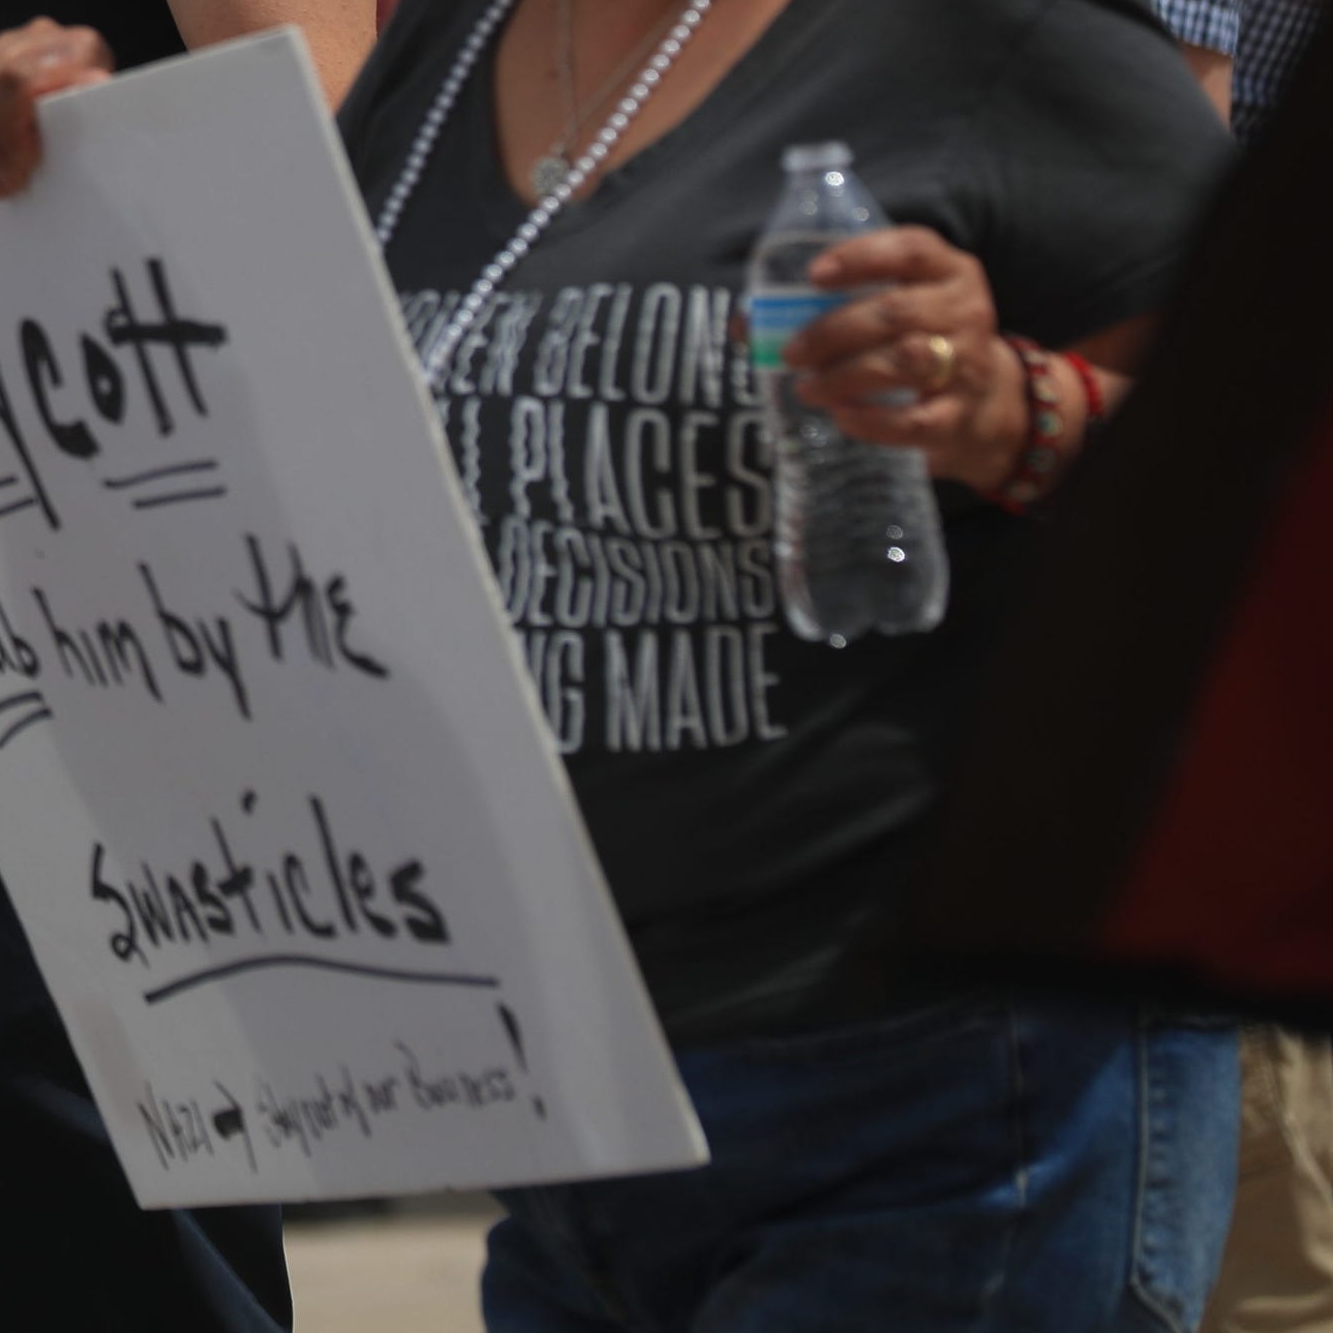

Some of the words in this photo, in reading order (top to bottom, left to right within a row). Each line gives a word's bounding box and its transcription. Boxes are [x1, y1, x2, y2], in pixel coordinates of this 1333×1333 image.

[510, 394, 775, 541] PLACES
[30, 586, 164, 704] him
[136, 559, 253, 723] by
[497, 515, 775, 629] DECISIONS
[605, 620, 788, 753] MADE
